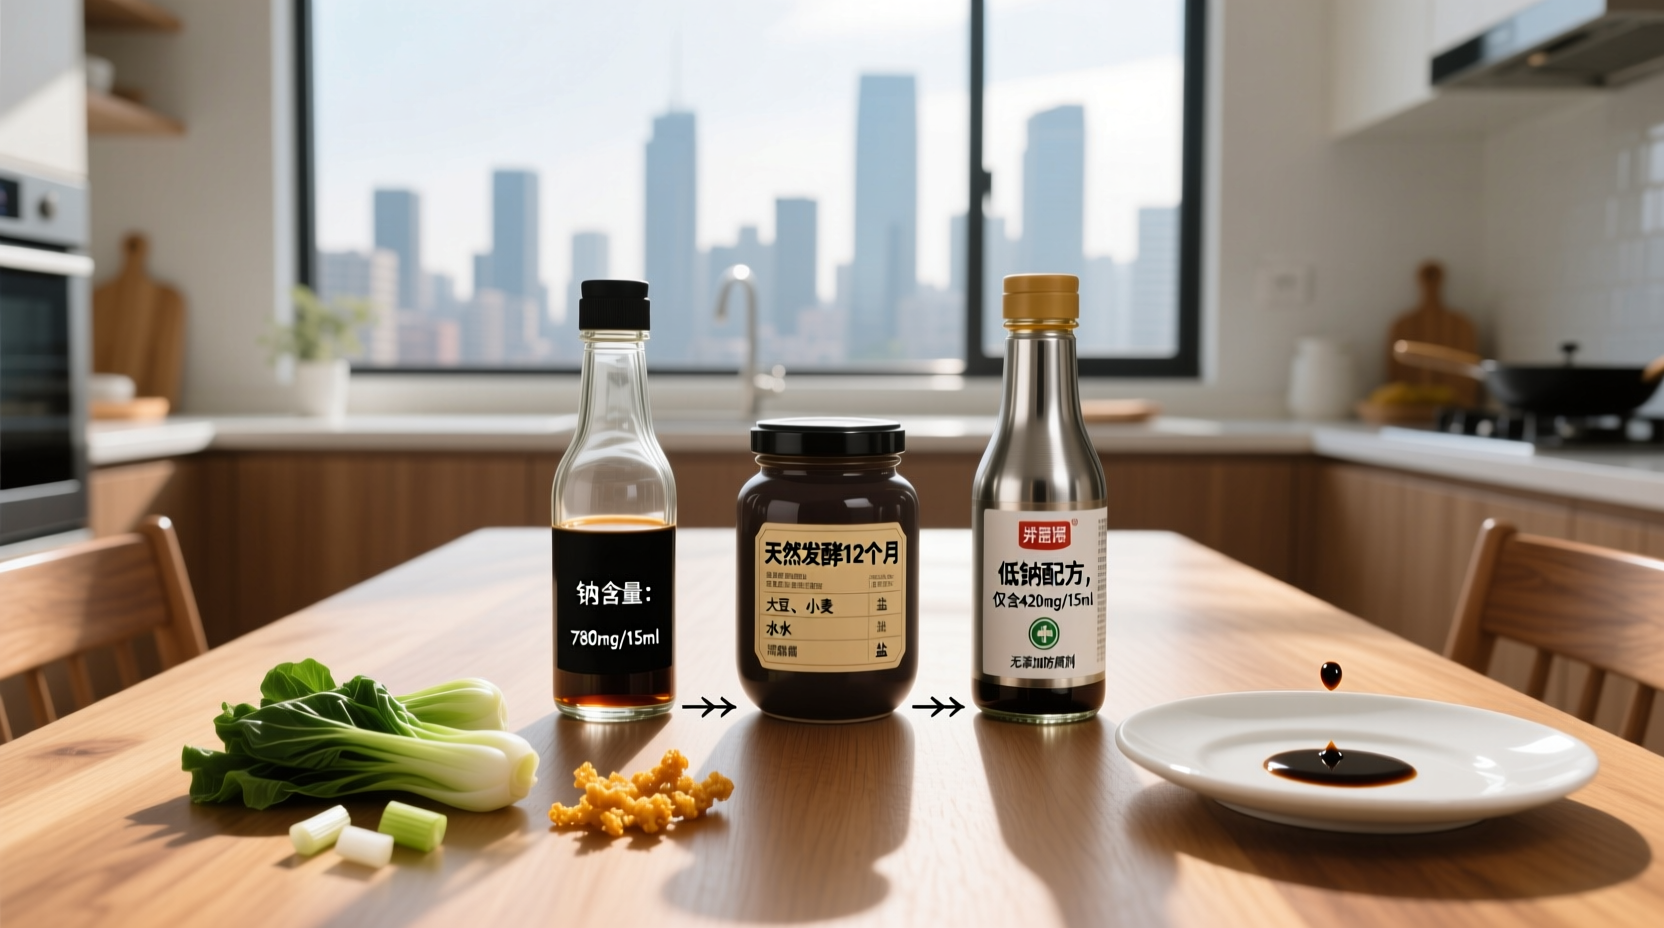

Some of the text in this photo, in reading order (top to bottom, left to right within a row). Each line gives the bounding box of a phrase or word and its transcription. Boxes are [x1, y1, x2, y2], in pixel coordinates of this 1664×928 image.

[764, 540, 899, 567] 天然发酵12个月
[766, 597, 834, 614] 大豆、小麦
[570, 628, 660, 650] 780mg/15ml
